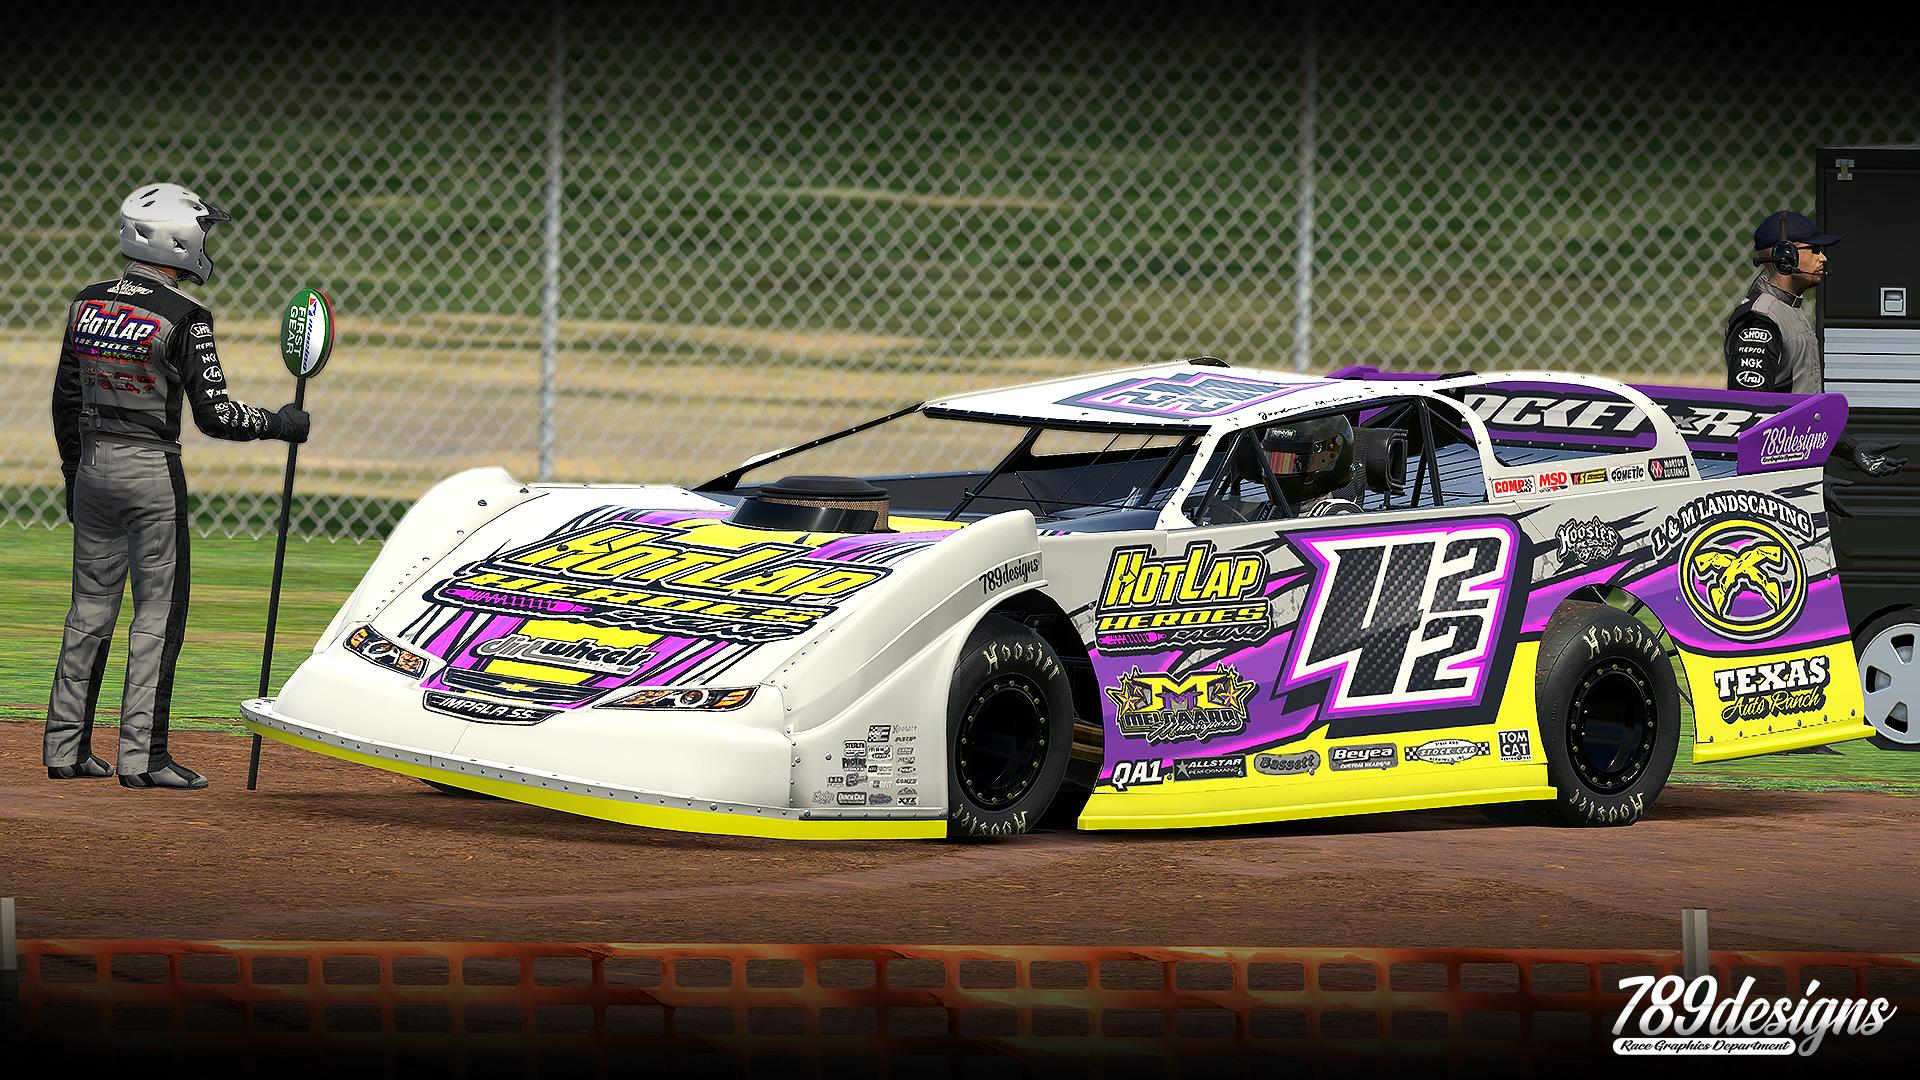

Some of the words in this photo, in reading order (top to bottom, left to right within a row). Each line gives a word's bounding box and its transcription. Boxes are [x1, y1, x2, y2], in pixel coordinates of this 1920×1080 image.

[285, 305, 299, 355] GEAR
[294, 306, 307, 358] FIRST
[1740, 357, 1763, 369] NGK
[1761, 425, 1829, 460] 789designs
[1494, 479, 1525, 494] COMP
[1539, 471, 1568, 488] MSD
[1653, 531, 1667, 549] L
[1668, 518, 1681, 538] &
[1680, 509, 1698, 529] M
[1698, 494, 1811, 535] LANDSCAPING
[978, 558, 1039, 595] 789designs
[456, 573, 827, 623] HEROES
[1097, 604, 1268, 631] HEROES
[1170, 625, 1268, 641] RACING
[1714, 656, 1828, 699] TEXAS
[439, 697, 507, 716] IMPALA
[507, 708, 535, 719] SS
[1722, 698, 1765, 720] Auto
[1768, 688, 1821, 713] Ranch
[1499, 731, 1528, 743] TOM
[1333, 747, 1394, 762] Beyea
[1420, 748, 1451, 757] STOCK
[1456, 746, 1476, 754] CAR
[1502, 742, 1529, 757] CAT
[1187, 758, 1243, 768] ALLSTAR
[1260, 754, 1315, 771] Bassett
[1112, 759, 1164, 790] QA1
